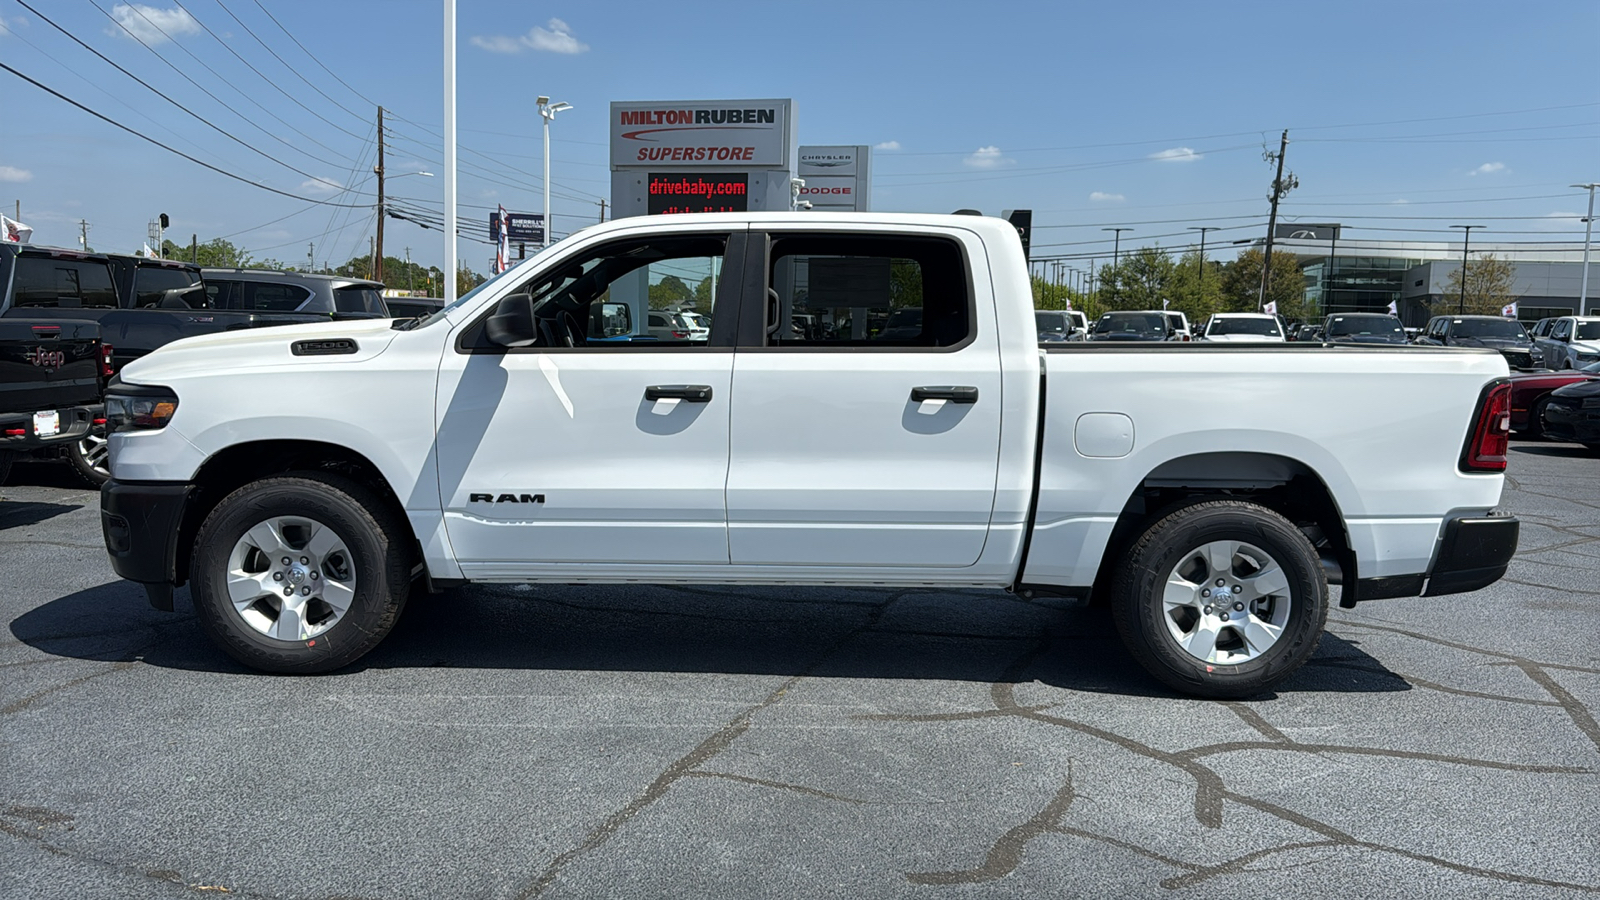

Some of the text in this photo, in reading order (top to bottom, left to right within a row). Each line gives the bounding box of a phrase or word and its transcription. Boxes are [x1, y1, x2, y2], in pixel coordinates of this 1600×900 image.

[621, 109, 775, 125] MILTON RUBEN
[637, 147, 755, 161] SUPERSTORE
[649, 178, 746, 199] drivebaby.com
[800, 187, 852, 195] DODGE
[299, 341, 350, 350] 1500
[32, 346, 65, 369] Jeep
[470, 493, 545, 504] RAM
